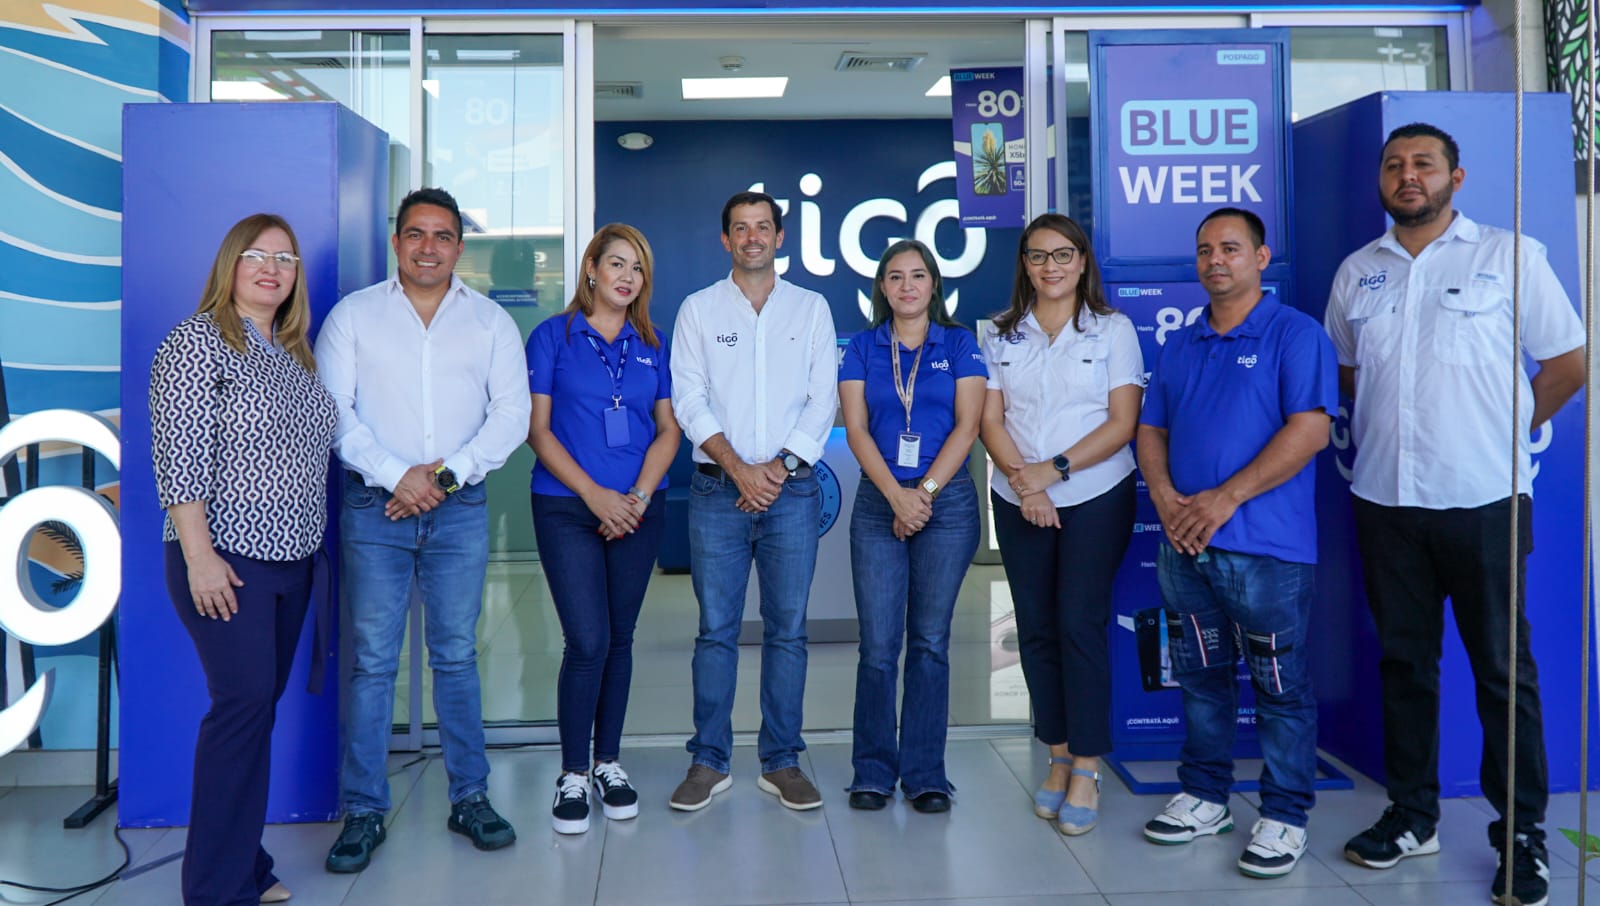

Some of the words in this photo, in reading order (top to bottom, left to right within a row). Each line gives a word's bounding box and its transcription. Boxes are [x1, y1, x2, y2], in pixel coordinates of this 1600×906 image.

[1223, 53, 1260, 61] POSPAGO
[974, 71, 995, 80] WEEK
[1129, 109, 1249, 146] BLUE
[1118, 164, 1263, 204] WEEK
[1119, 288, 1139, 297] BLUE
[1139, 288, 1163, 296] WEEK
[1144, 523, 1161, 531] WEE
